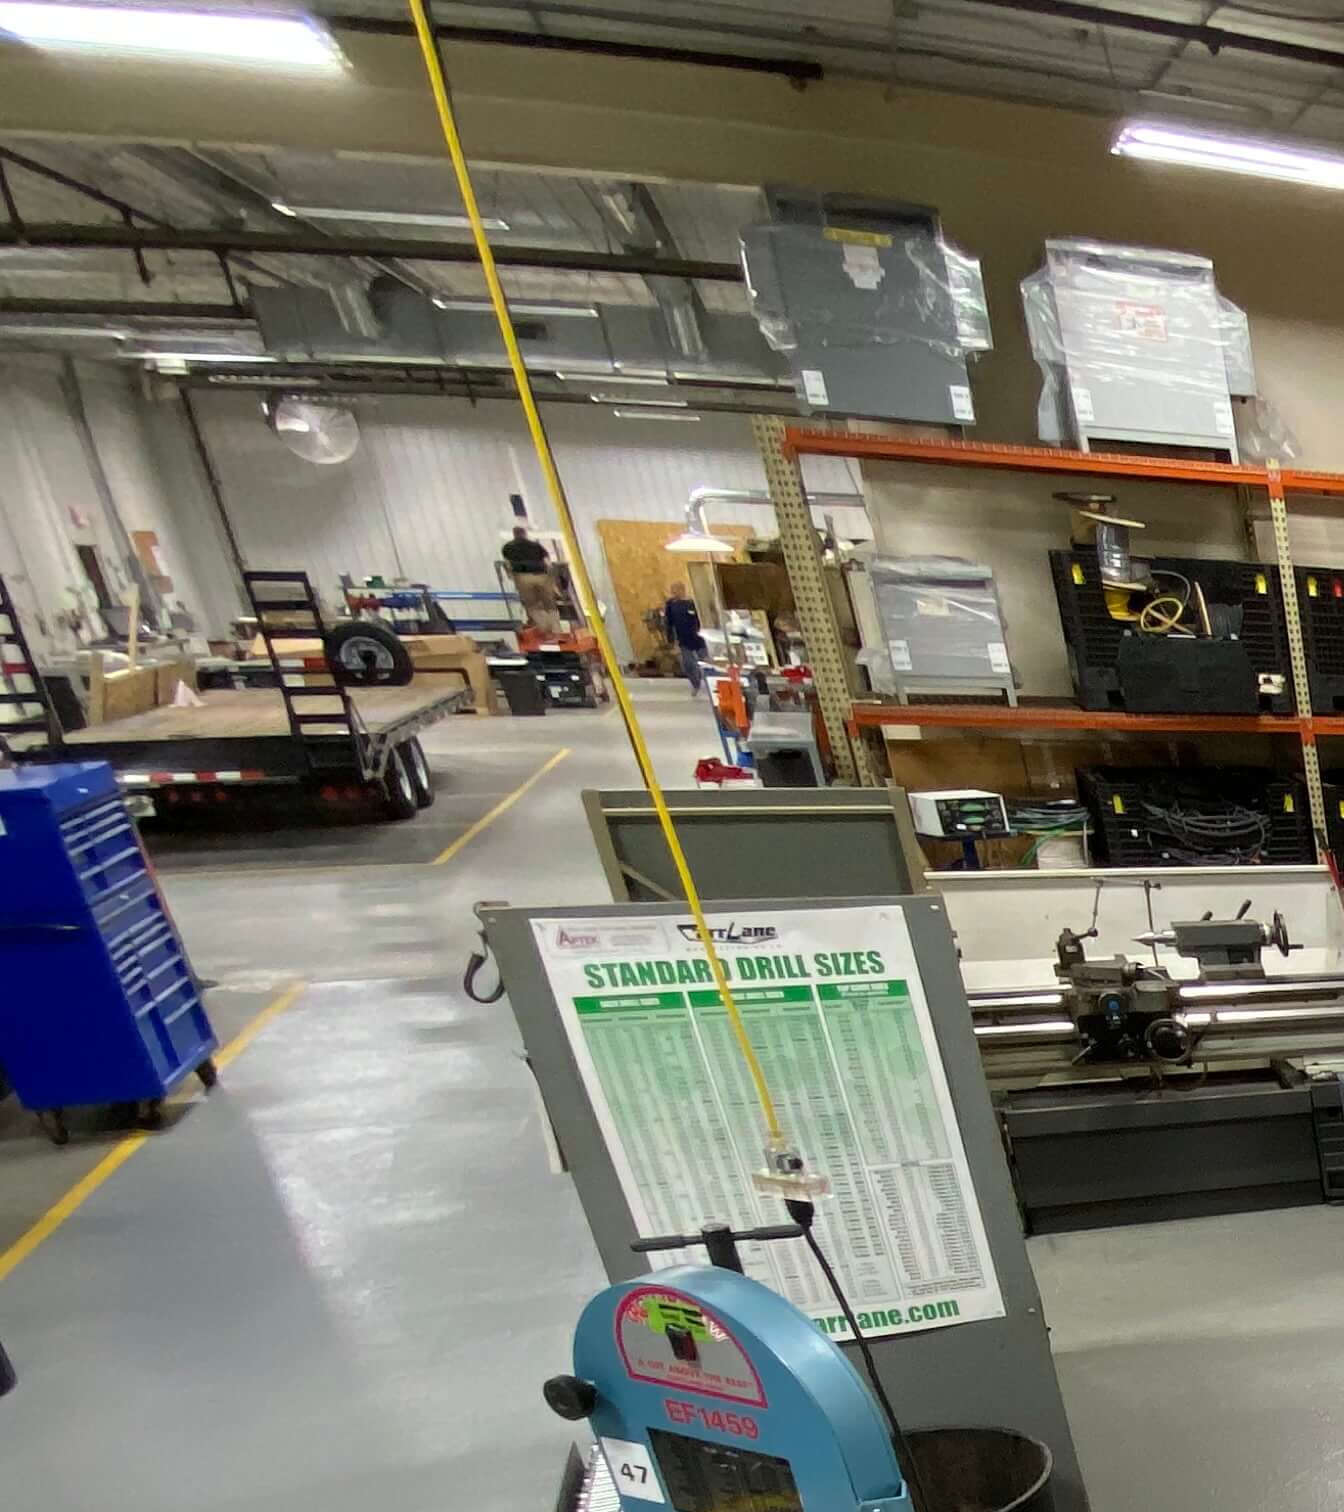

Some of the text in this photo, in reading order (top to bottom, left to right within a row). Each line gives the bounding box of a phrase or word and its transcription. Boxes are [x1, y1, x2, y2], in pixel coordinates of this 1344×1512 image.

[738, 954, 811, 982] DRILL
[815, 951, 885, 976] SIZES
[664, 1399, 758, 1440] EF1459
[620, 1463, 648, 1484] 47
